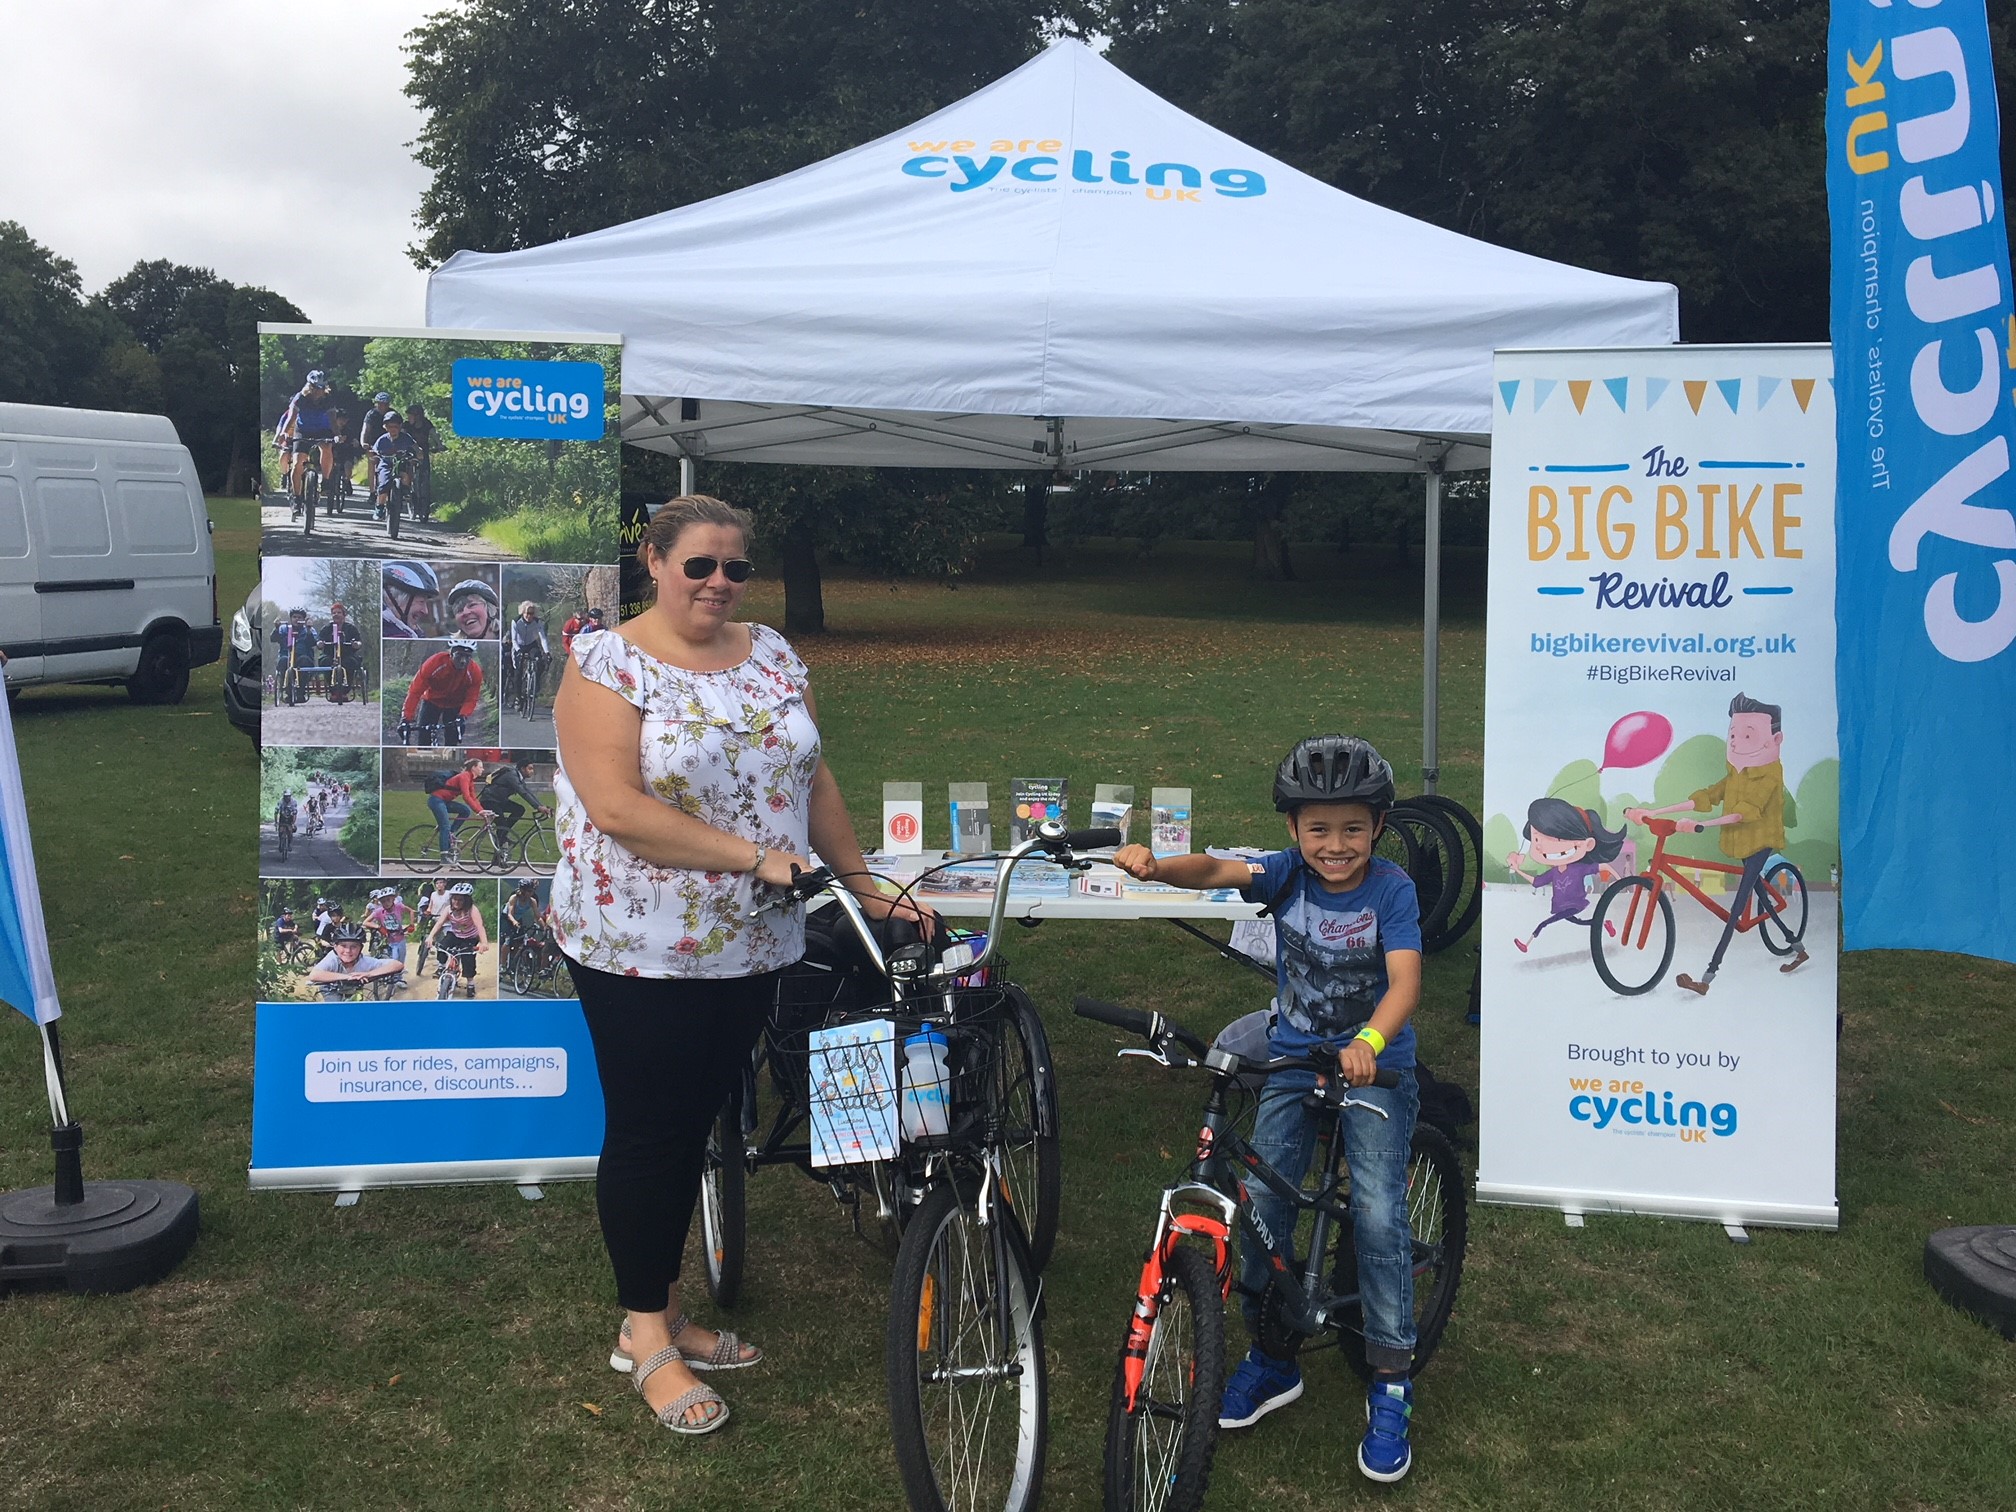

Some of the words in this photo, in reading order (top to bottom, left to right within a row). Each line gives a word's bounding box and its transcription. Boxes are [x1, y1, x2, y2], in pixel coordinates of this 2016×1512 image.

[907, 140, 976, 153] we
[989, 139, 1063, 153] are
[901, 149, 1267, 197] cycling
[1145, 187, 1203, 202] UK
[467, 376, 492, 388] we
[496, 377, 523, 389] are
[467, 385, 589, 419] cycling
[547, 413, 567, 425] UK
[1642, 445, 1689, 478] The
[1527, 485, 1636, 561] BIG
[1655, 483, 1804, 560] BIKE
[1588, 571, 1734, 610] Revival
[1530, 633, 1797, 658] bigbikerevival.org.uk
[1586, 665, 1737, 684] #BigBikeRevival
[1346, 936, 1366, 948] 66
[317, 1058, 351, 1074] Join
[358, 1060, 378, 1073] us
[384, 1056, 407, 1072] for
[412, 1056, 458, 1073] rides,
[464, 1054, 560, 1073] campaigns,
[1567, 1043, 1645, 1067] Brought
[1651, 1048, 1670, 1065] to
[1676, 1051, 1711, 1069] you
[1718, 1051, 1741, 1072] by
[339, 1077, 427, 1094] insurance,
[1569, 1077, 1603, 1092] we
[1608, 1079, 1644, 1094] are
[1569, 1091, 1737, 1137] cycling
[1680, 1128, 1707, 1143] UK
